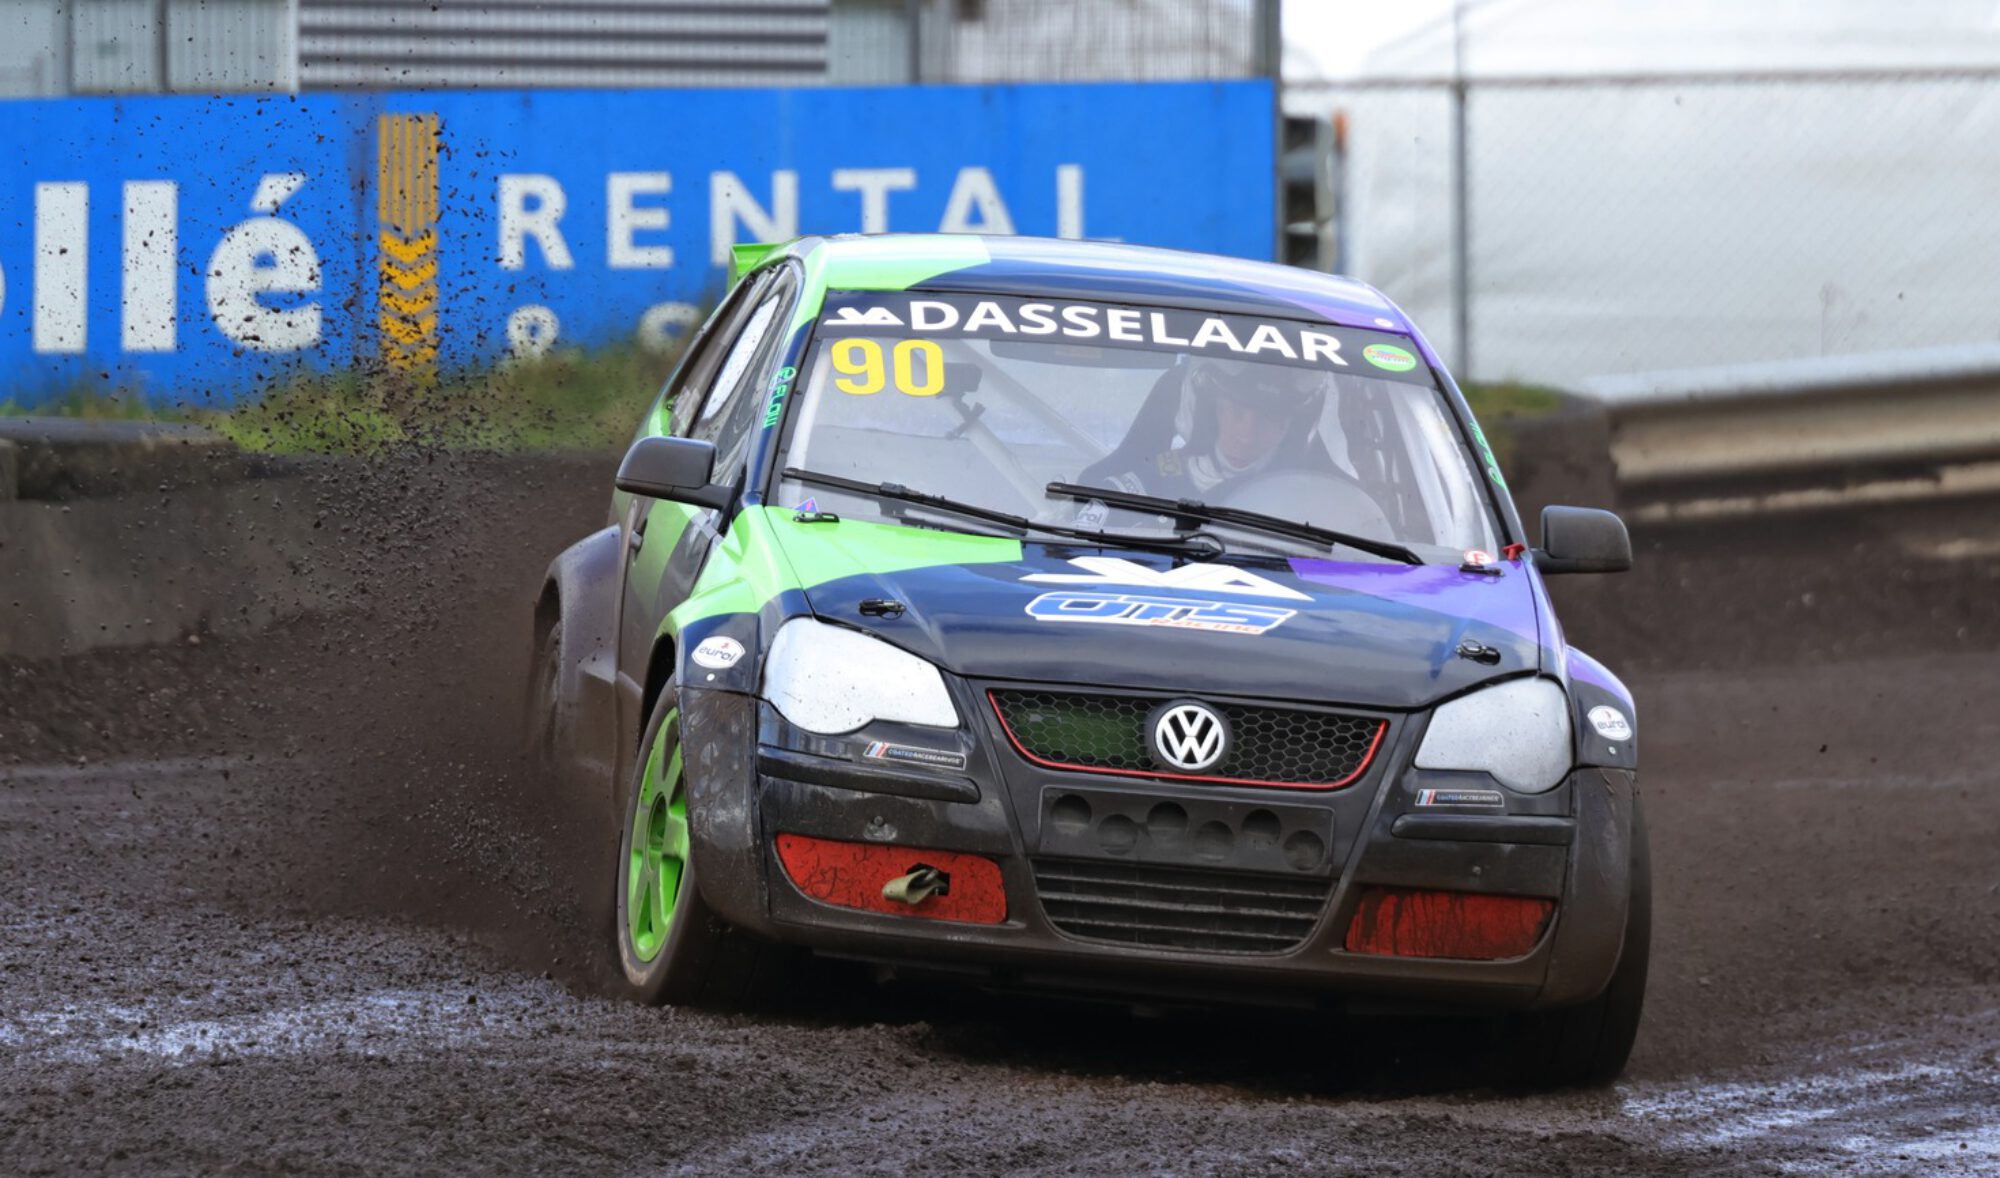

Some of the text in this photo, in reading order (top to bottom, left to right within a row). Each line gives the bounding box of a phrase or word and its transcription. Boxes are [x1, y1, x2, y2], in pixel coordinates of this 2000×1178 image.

[498, 163, 1124, 270] RENTAL
[0, 173, 324, 354] llé
[909, 300, 1349, 366] DASSELAAR
[831, 338, 946, 397] 90
[698, 645, 739, 662] eurol
[1155, 705, 1225, 770] VW
